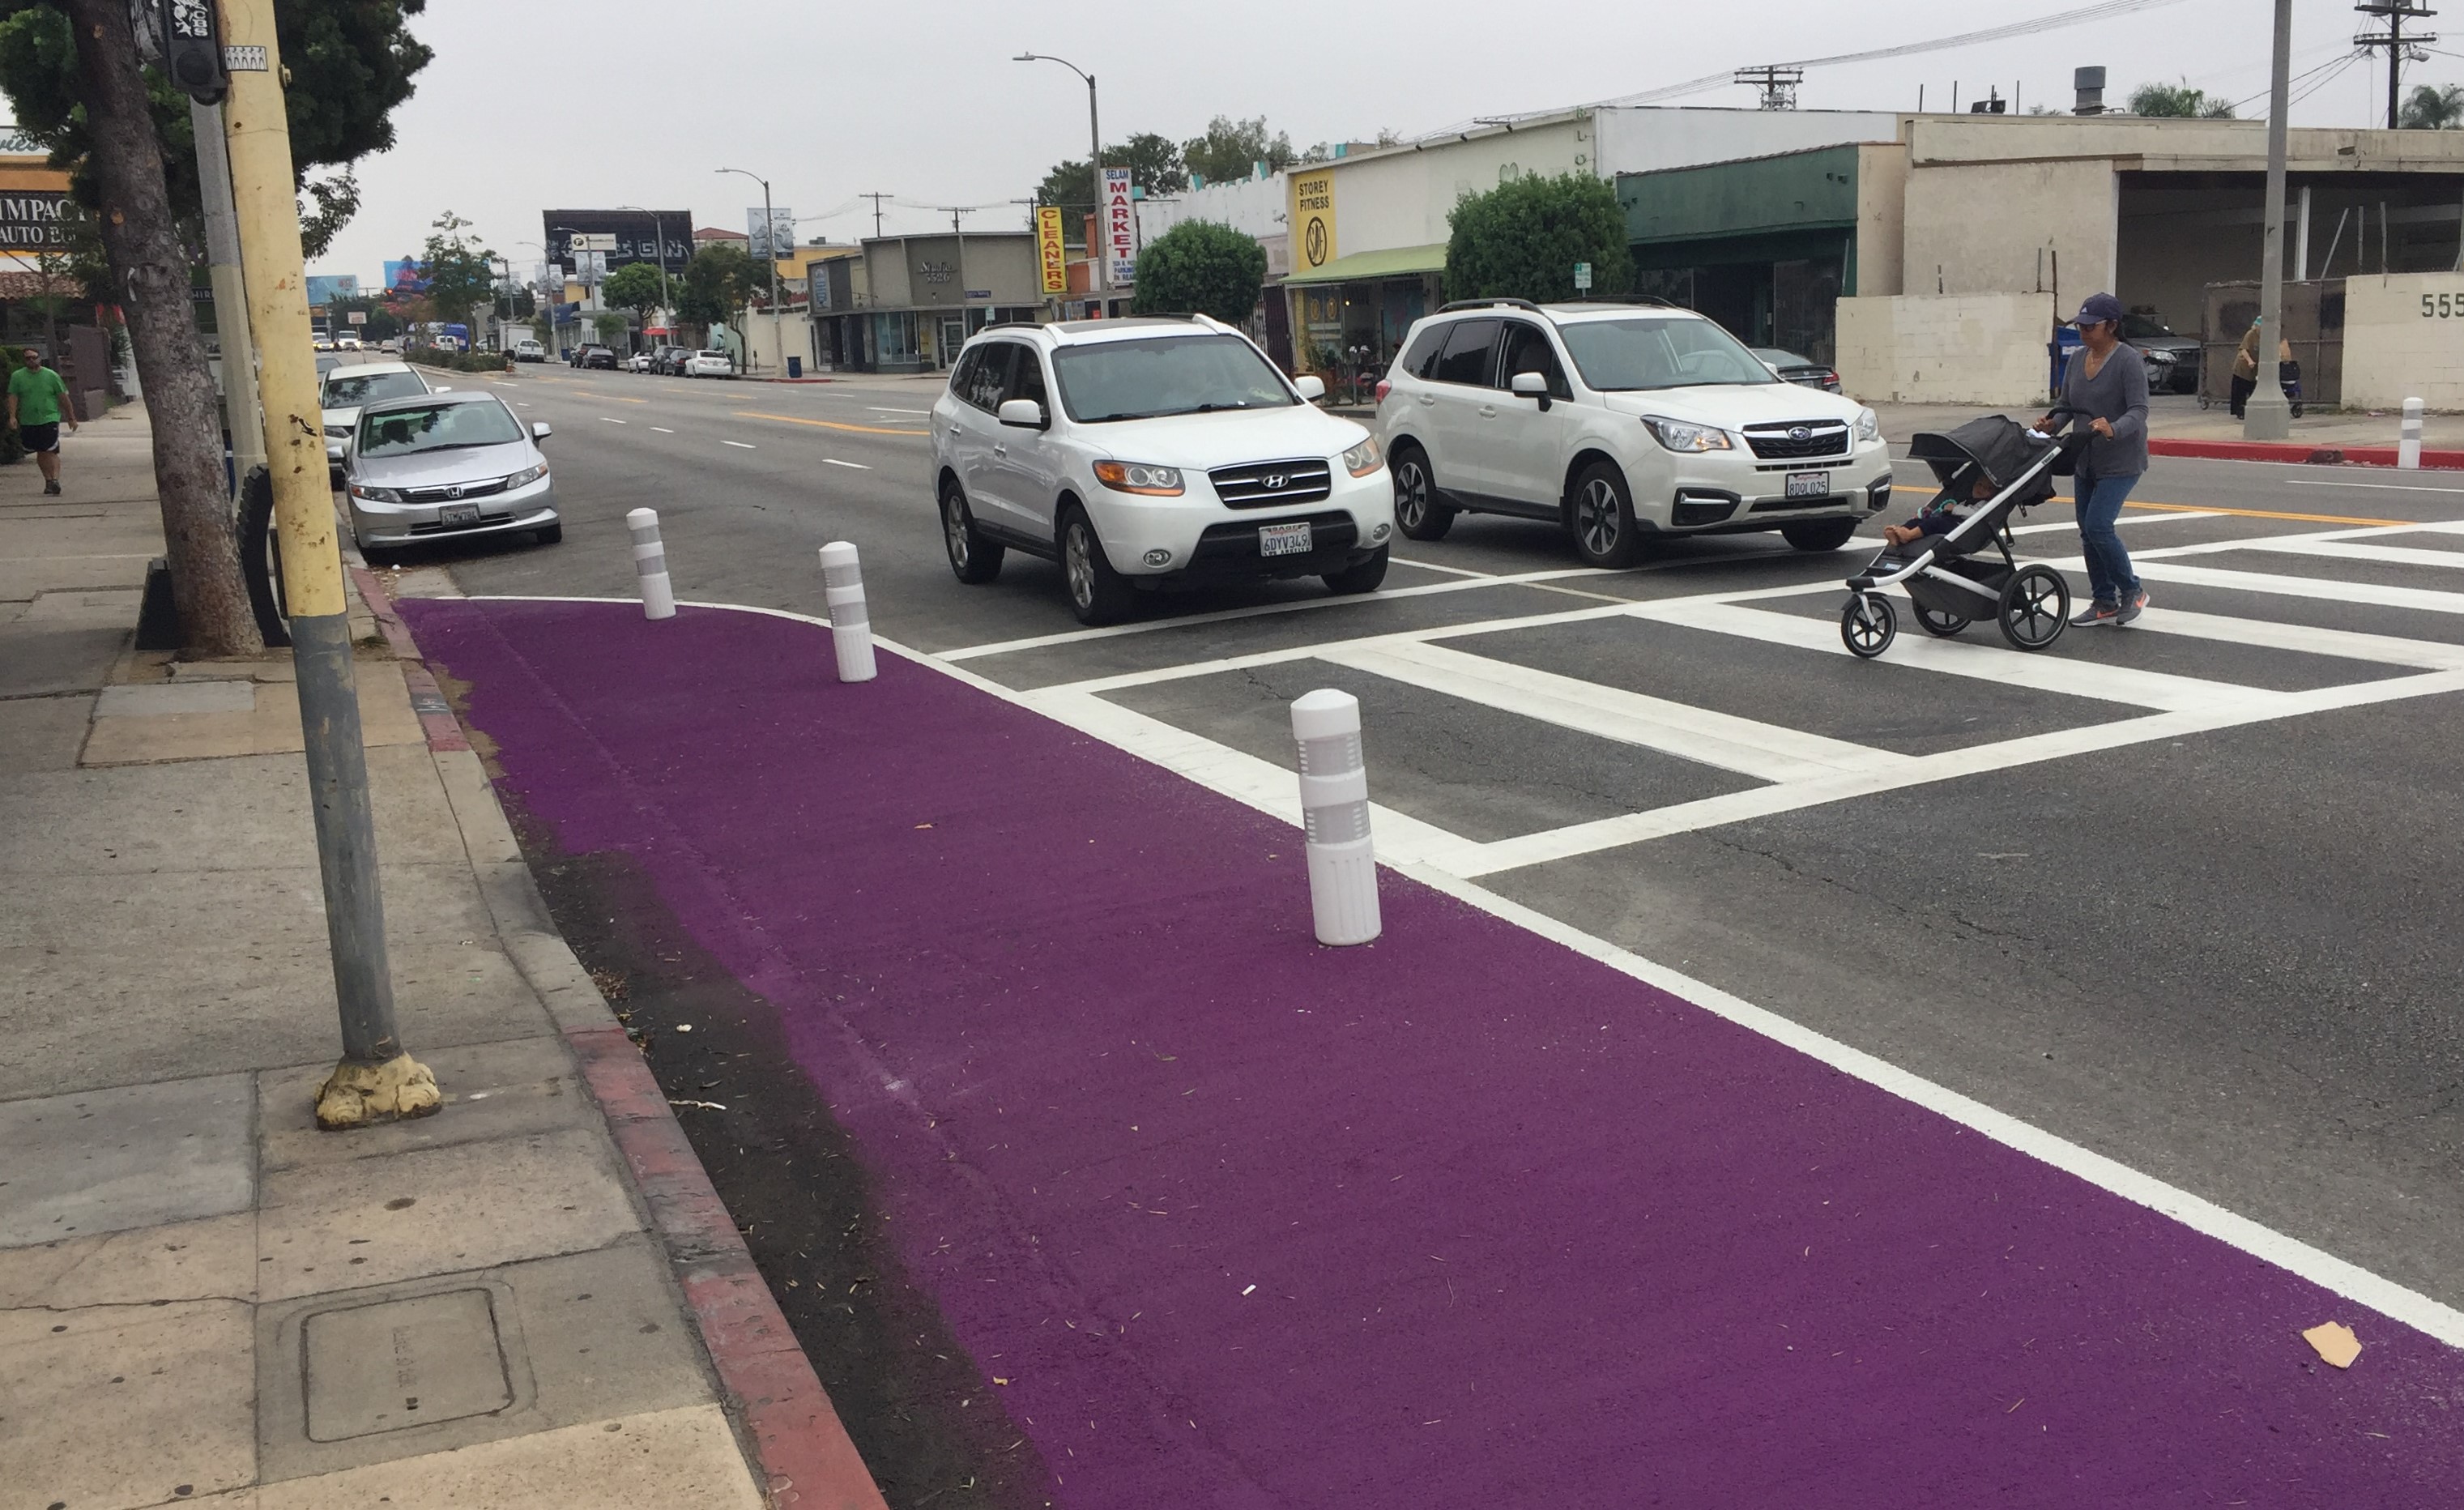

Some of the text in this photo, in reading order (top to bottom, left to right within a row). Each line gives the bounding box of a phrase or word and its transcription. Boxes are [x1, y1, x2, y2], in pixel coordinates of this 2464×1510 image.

[1106, 169, 1129, 180] SELAM
[1298, 180, 1329, 196] STOREY
[1299, 195, 1330, 212] FITNESS
[1110, 181, 1131, 258] MARKET
[0, 225, 44, 243] AUTO
[1041, 209, 1063, 289] CLEANERS
[920, 261, 953, 273] Studio
[2422, 292, 2464, 318] 555
[1264, 534, 1308, 552] 6DYV349
